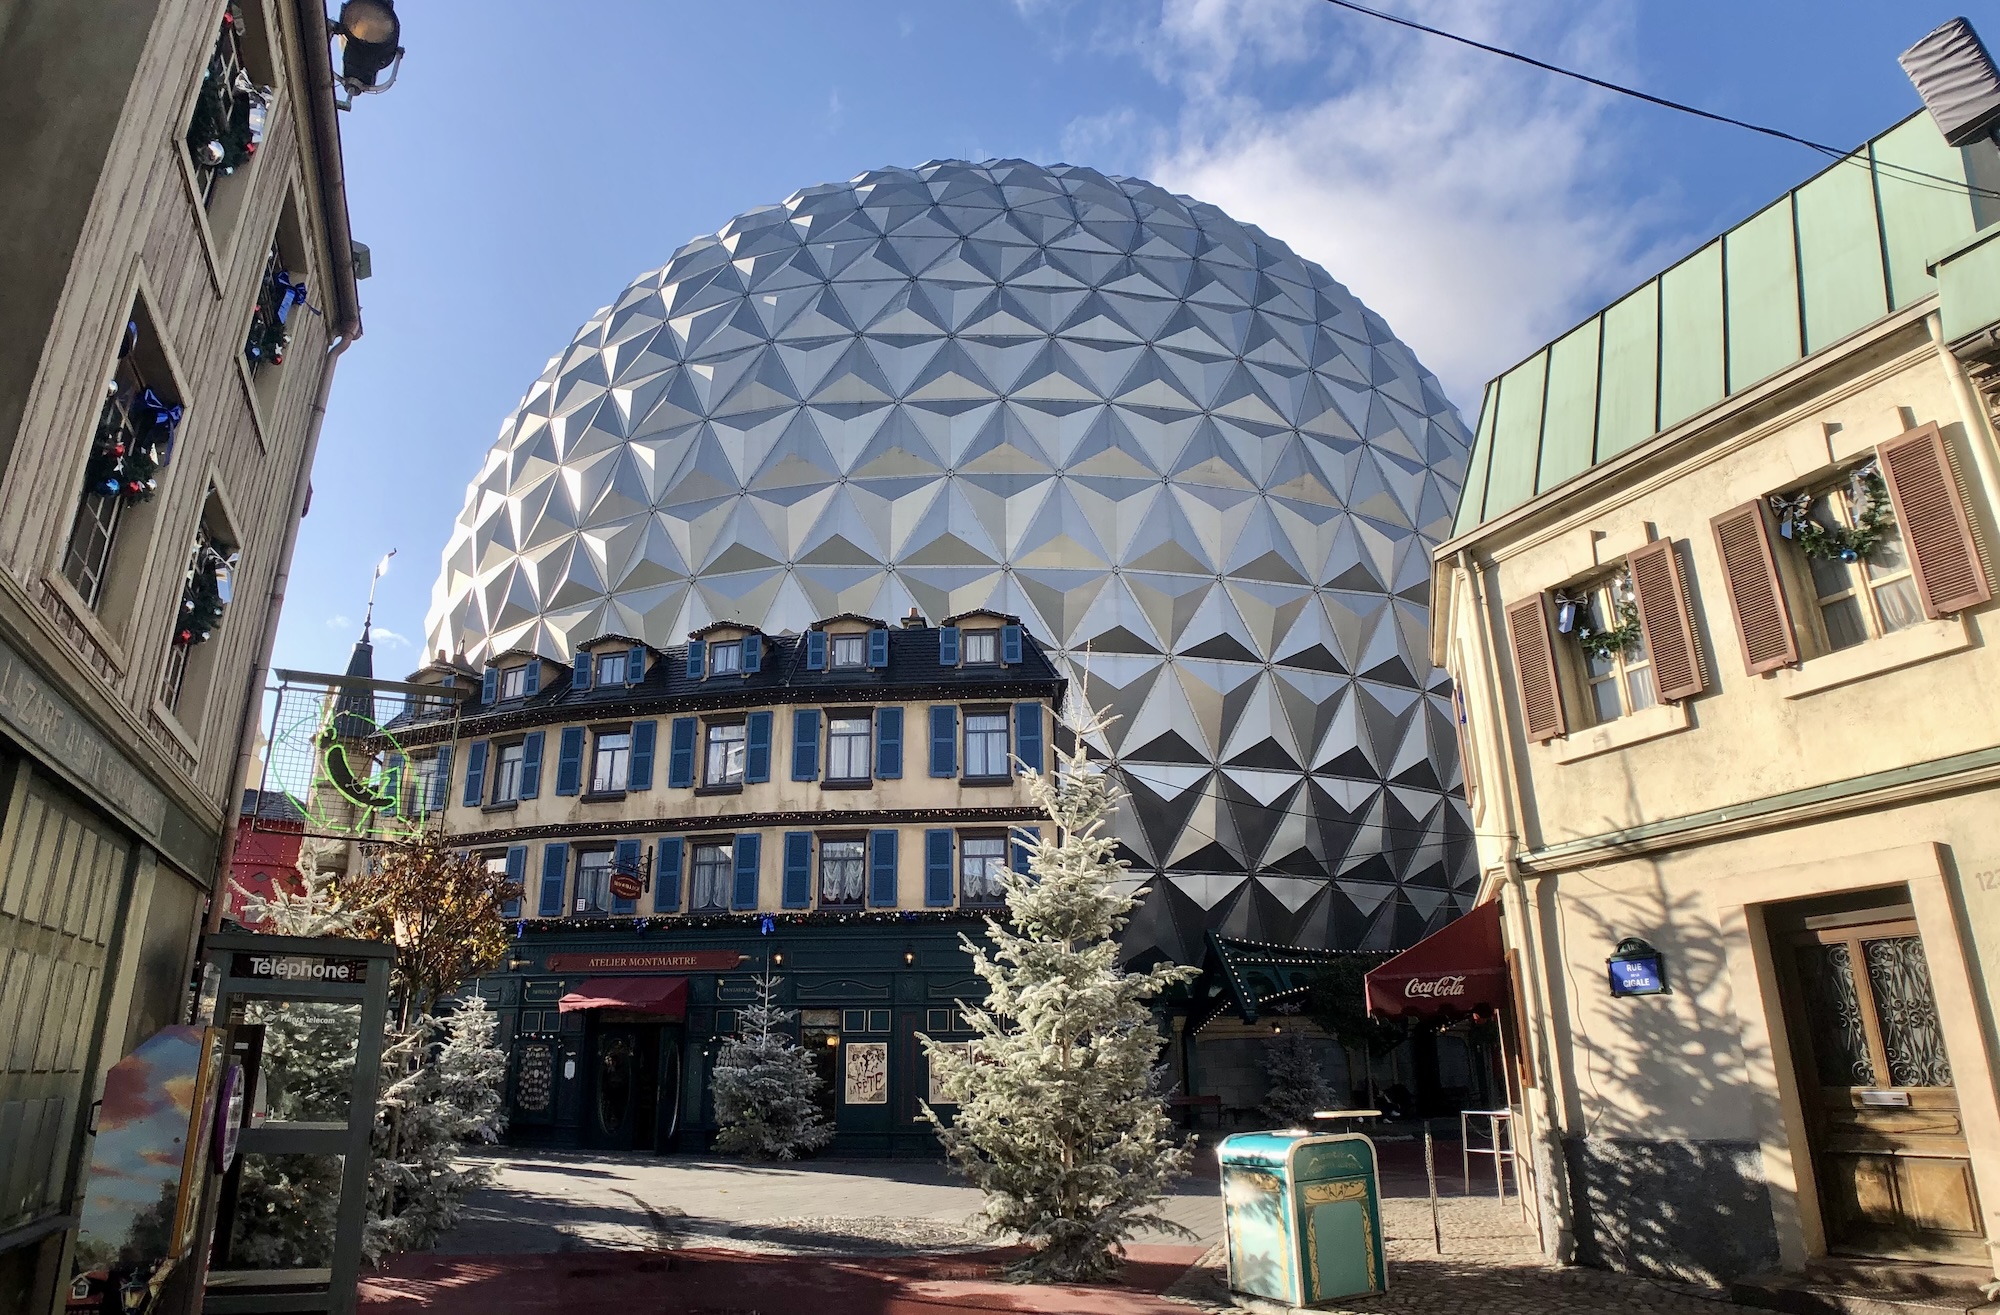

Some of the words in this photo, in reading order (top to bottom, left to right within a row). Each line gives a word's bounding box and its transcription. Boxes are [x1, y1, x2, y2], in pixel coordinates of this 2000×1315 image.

[588, 958, 628, 967] ATELIER
[628, 956, 697, 967] MONTMARTRE
[250, 957, 350, 979] Téléphone
[1626, 963, 1642, 972] RUE
[1623, 978, 1650, 988] CIGALE
[305, 1016, 336, 1024] Telecom
